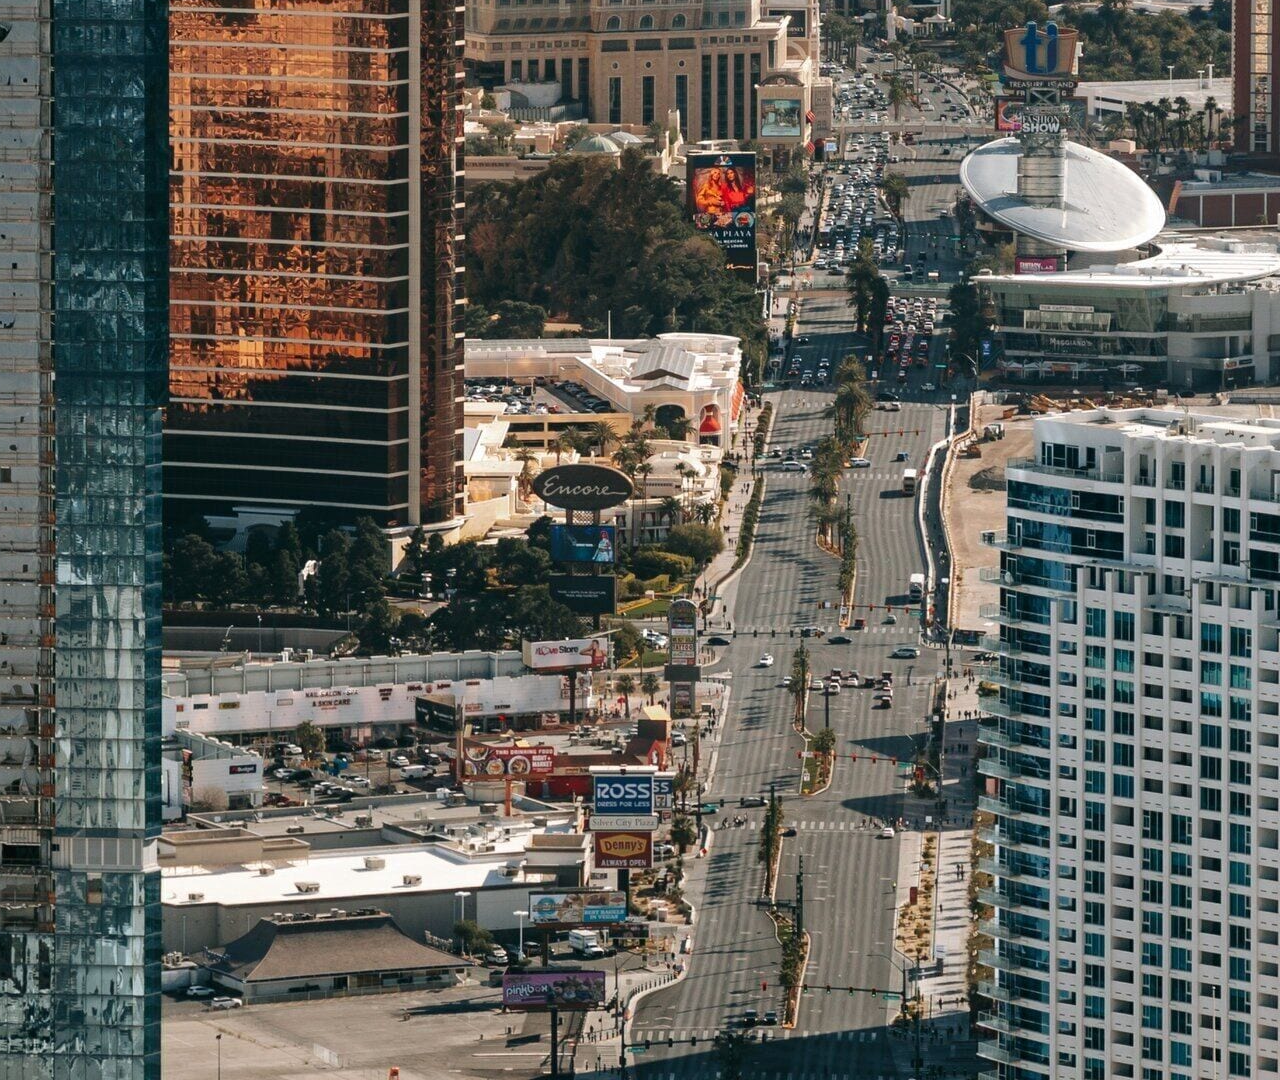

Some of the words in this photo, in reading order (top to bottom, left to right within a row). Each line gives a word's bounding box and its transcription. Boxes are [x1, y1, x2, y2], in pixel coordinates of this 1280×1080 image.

[1023, 115, 1060, 123] FASHION
[1022, 123, 1060, 133] SHOW
[723, 229, 752, 238] PLAYA
[543, 475, 628, 497] Encore
[559, 645, 579, 654] Store
[320, 690, 342, 698] SALON
[597, 783, 650, 799] ROSS
[592, 818, 613, 826] Silver
[615, 818, 632, 828] City
[634, 818, 656, 826] Plaza
[604, 839, 644, 852] Denny's
[601, 859, 627, 867] ALWAYS
[629, 859, 647, 867] OPEN
[506, 984, 548, 997] pinkbox
